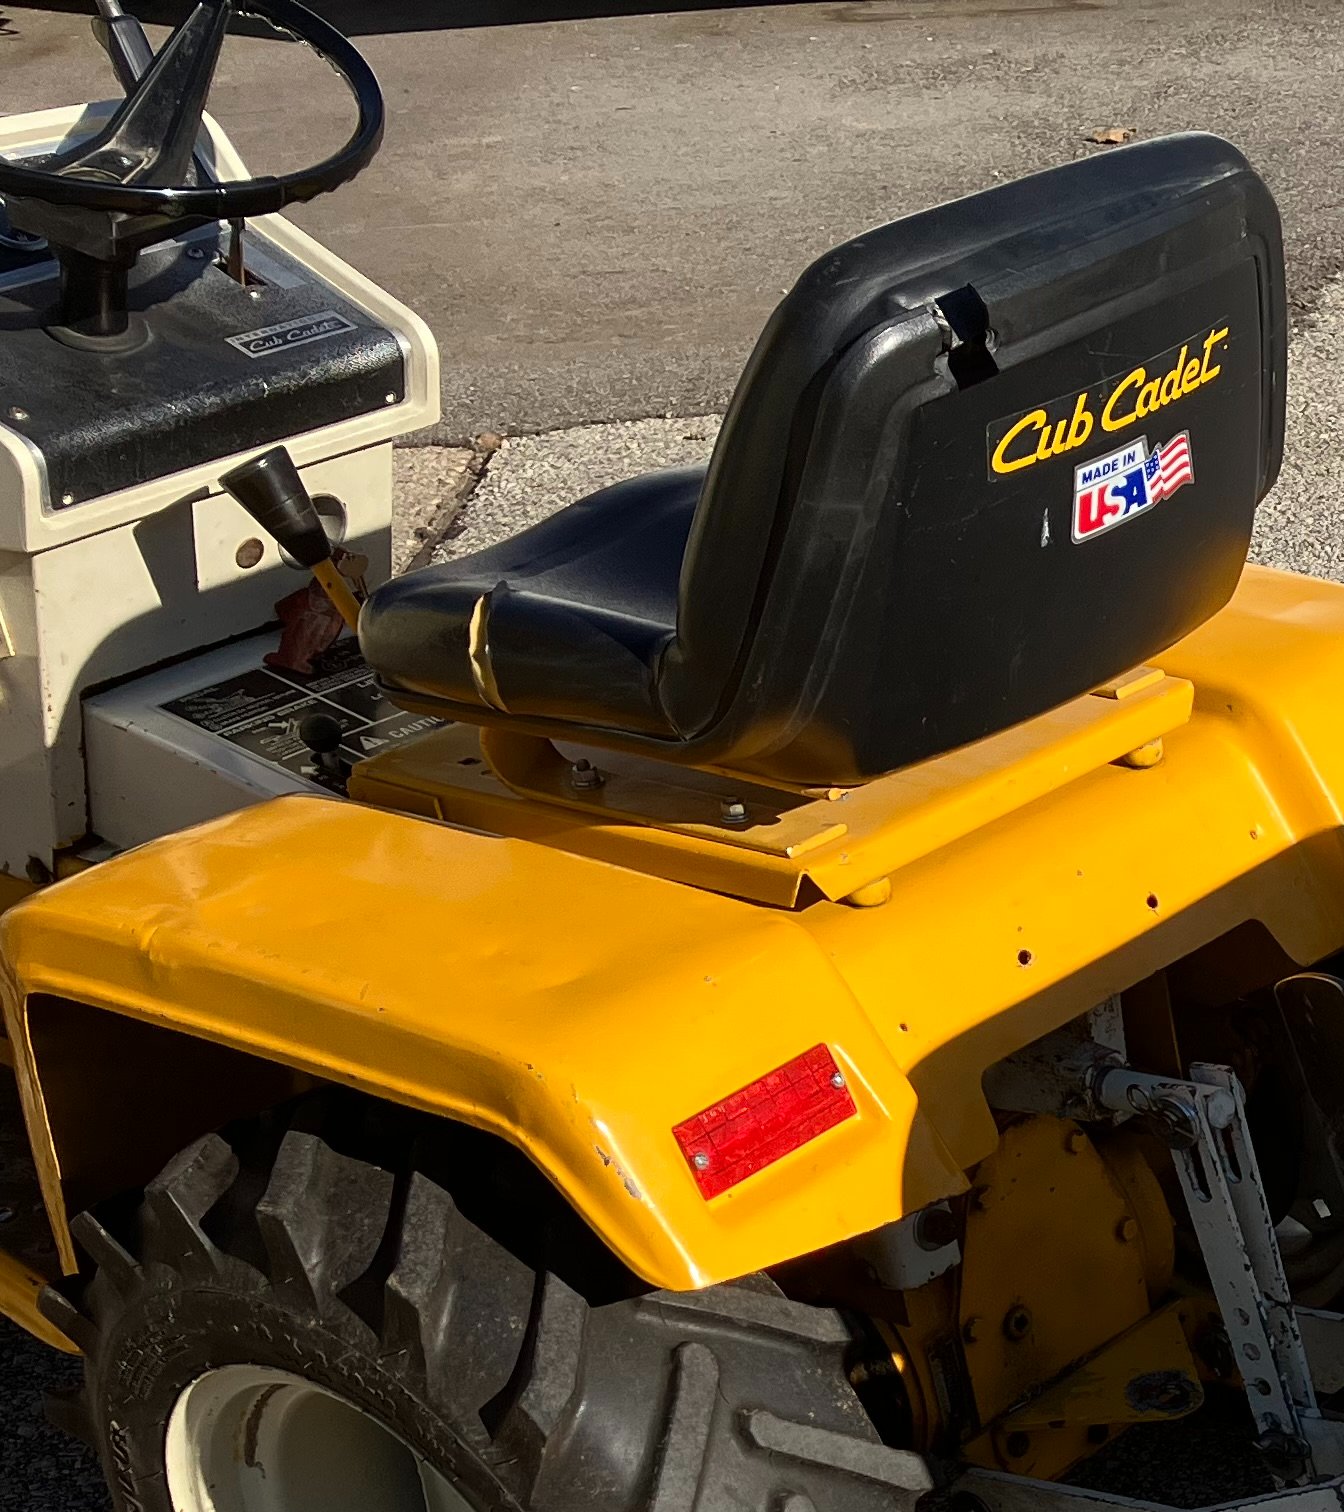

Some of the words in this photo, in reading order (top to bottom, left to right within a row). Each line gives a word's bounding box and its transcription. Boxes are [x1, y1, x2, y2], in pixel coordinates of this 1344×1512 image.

[249, 336, 283, 351] Cub
[991, 392, 1094, 474] Cub
[1101, 326, 1229, 432] Cadet
[1081, 461, 1119, 485] MADE
[1122, 450, 1136, 469] IN
[1078, 467, 1148, 534] USA
[388, 715, 445, 738] CAUTI
